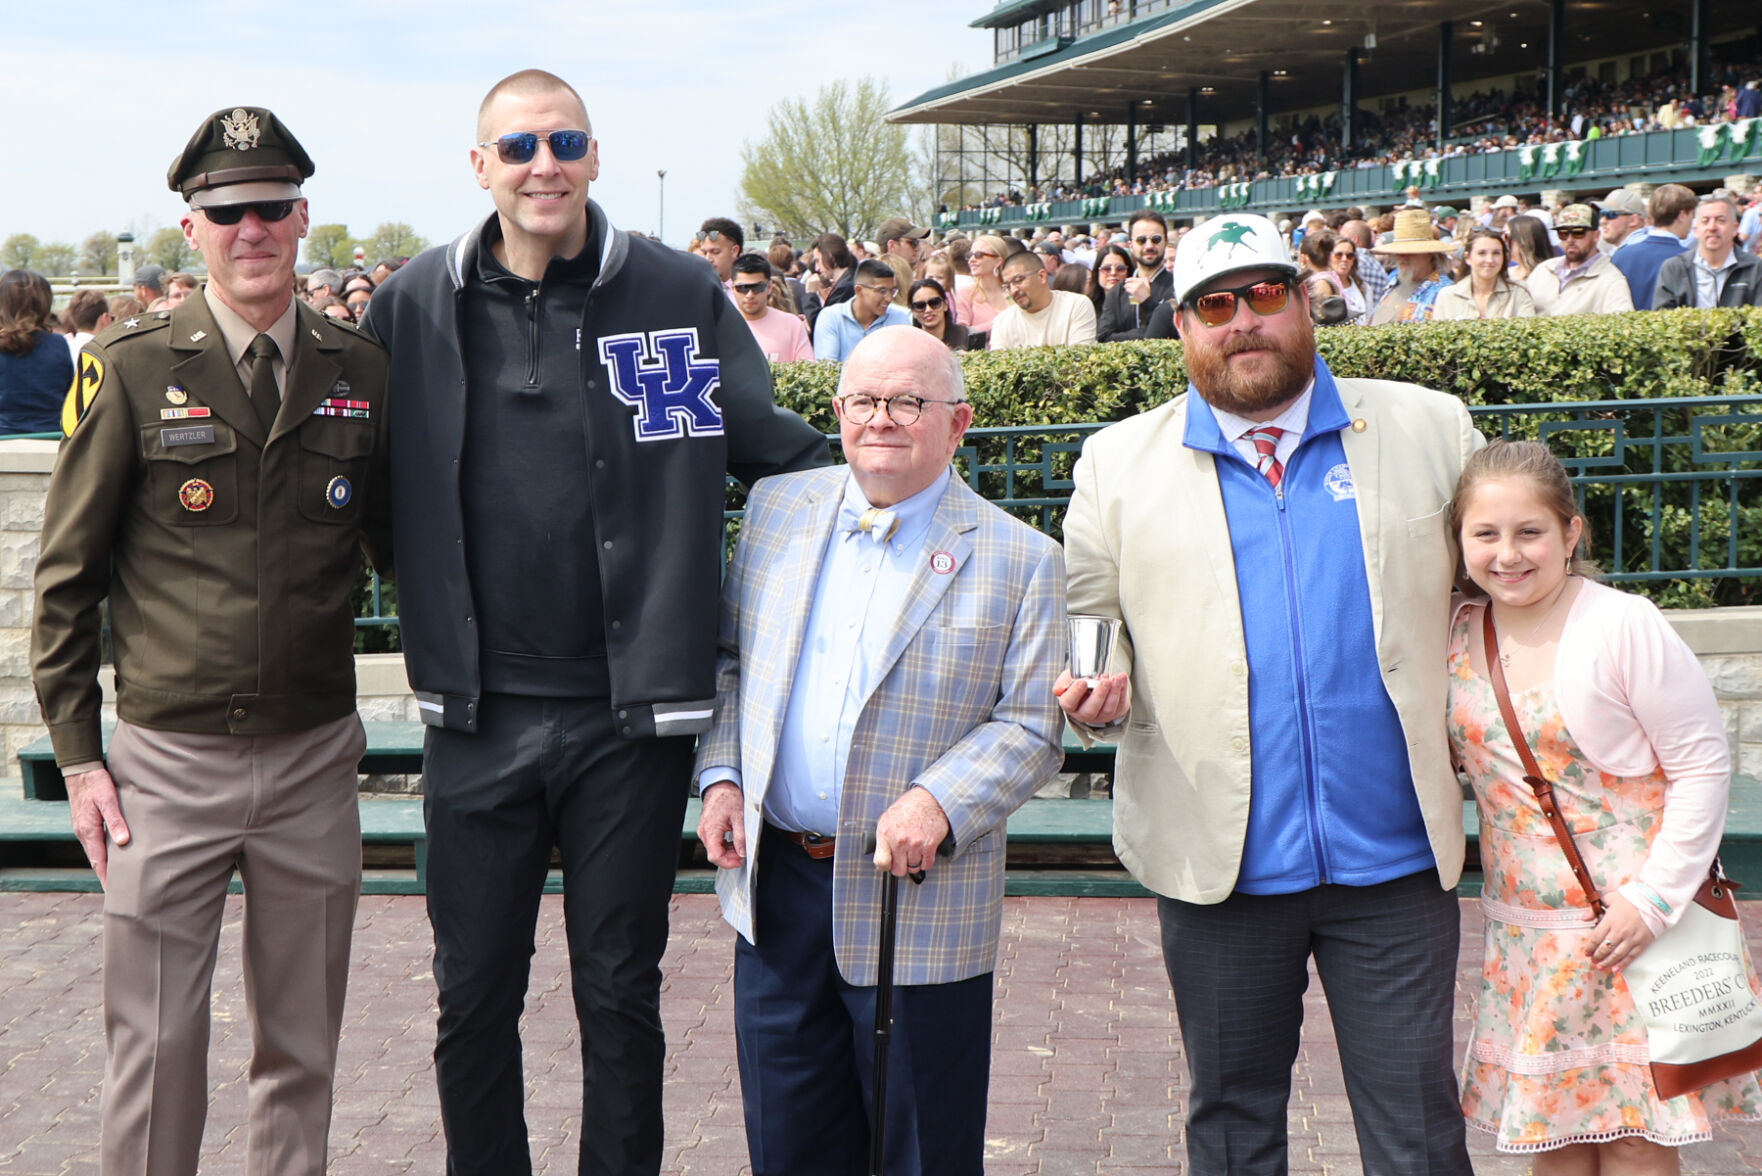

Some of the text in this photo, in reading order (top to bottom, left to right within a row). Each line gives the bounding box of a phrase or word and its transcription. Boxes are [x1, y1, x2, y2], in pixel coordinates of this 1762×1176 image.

[597, 327, 725, 442] UK
[168, 431, 207, 441] WERTZLER
[1650, 958, 1696, 993] KEENELAND
[1694, 968, 1714, 980] 2022
[1648, 976, 1731, 1017] BREEDERS'
[1698, 999, 1736, 1018] MMXXII
[1673, 1001, 1756, 1033] LEXINGTON, KENTUCK
